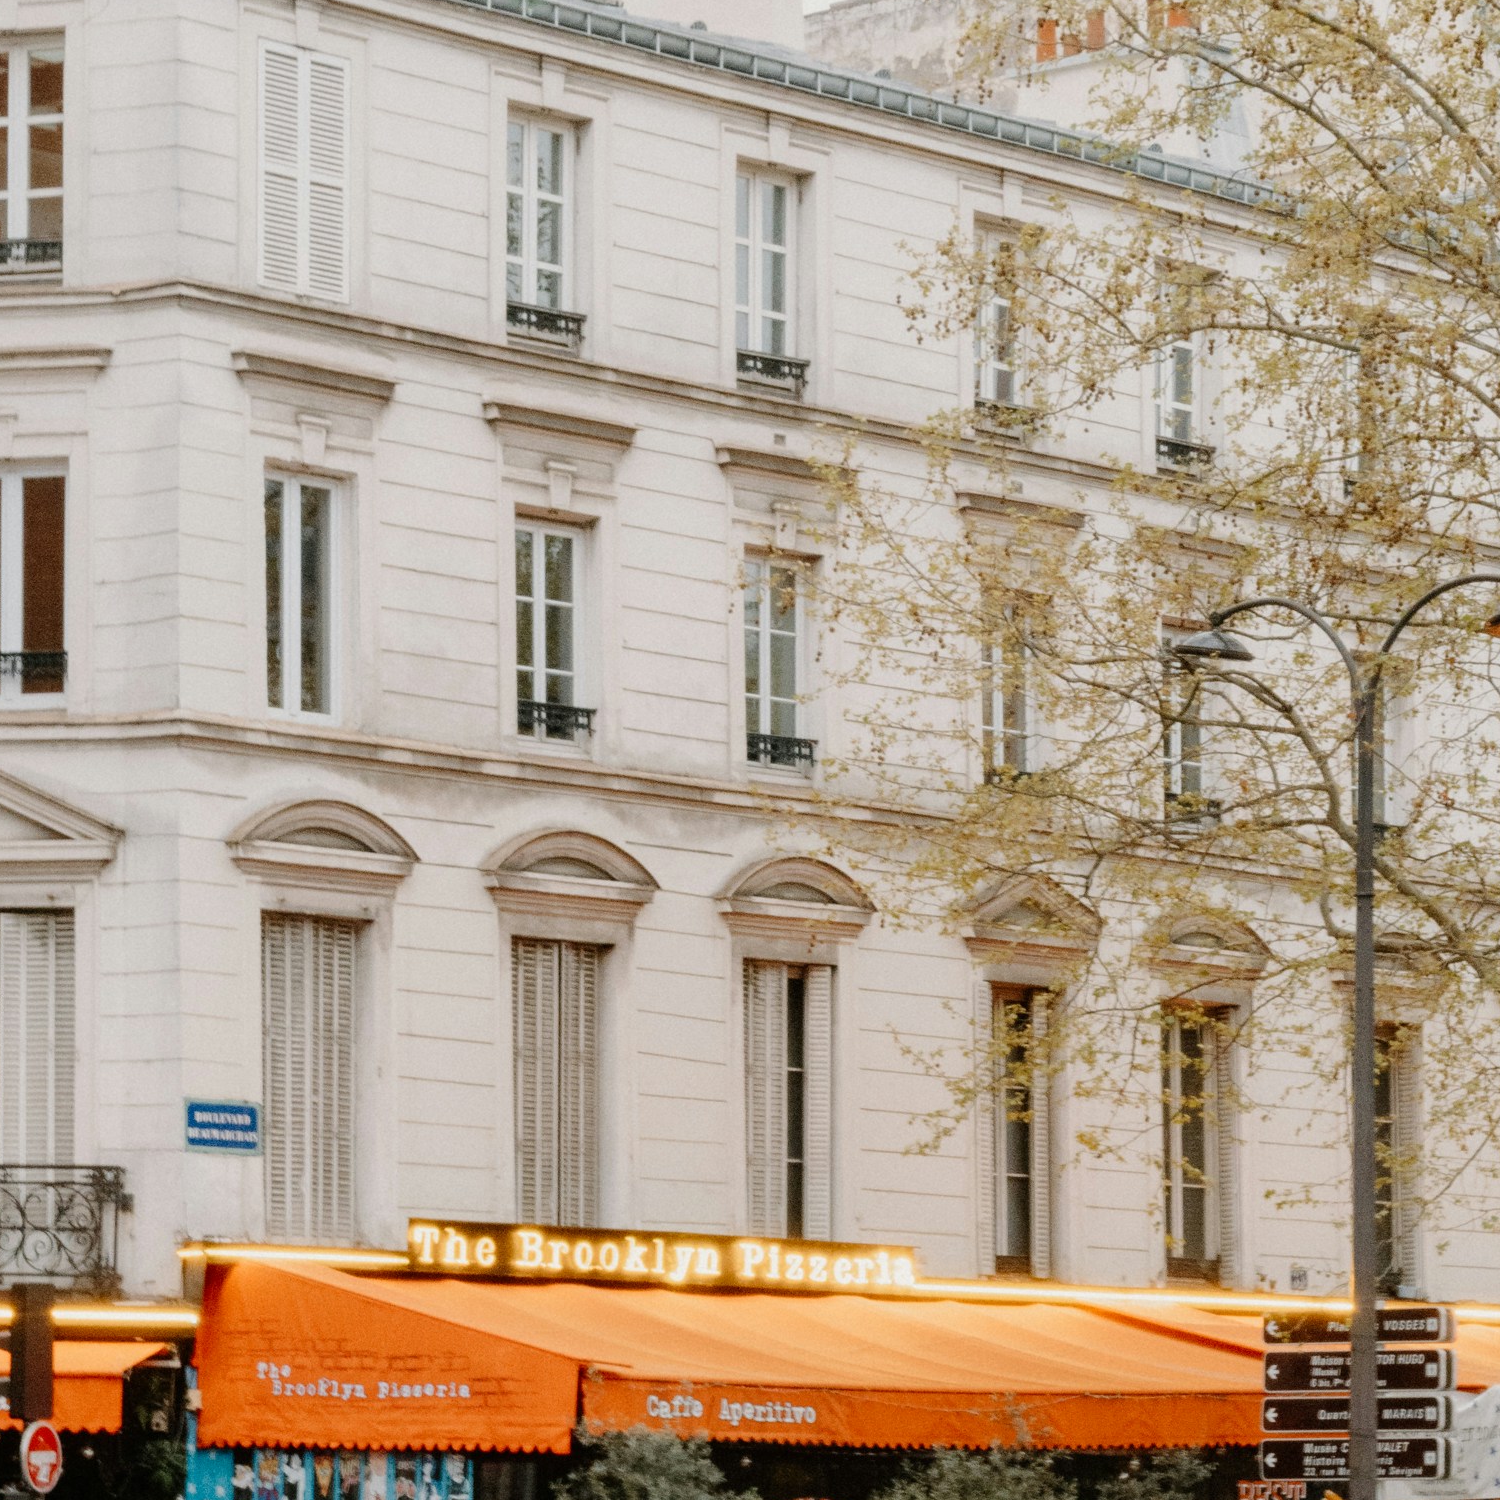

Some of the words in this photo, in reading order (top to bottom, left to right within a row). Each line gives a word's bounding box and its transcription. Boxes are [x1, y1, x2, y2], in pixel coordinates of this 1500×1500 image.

[411, 1225, 497, 1269] The
[513, 1229, 722, 1286] Brooklyn
[738, 1241, 916, 1287] Pizzeria
[1327, 1320, 1350, 1332] Pla
[1383, 1319, 1426, 1331] VOSGES
[1376, 1354, 1397, 1365] TOR
[1397, 1354, 1425, 1365] HUGO
[256, 1360, 292, 1380] The
[271, 1376, 368, 1401] Brooklyn
[718, 1397, 817, 1427] Aperitivo
[1317, 1409, 1350, 1421] Quart
[1382, 1408, 1425, 1420] MARAIS
